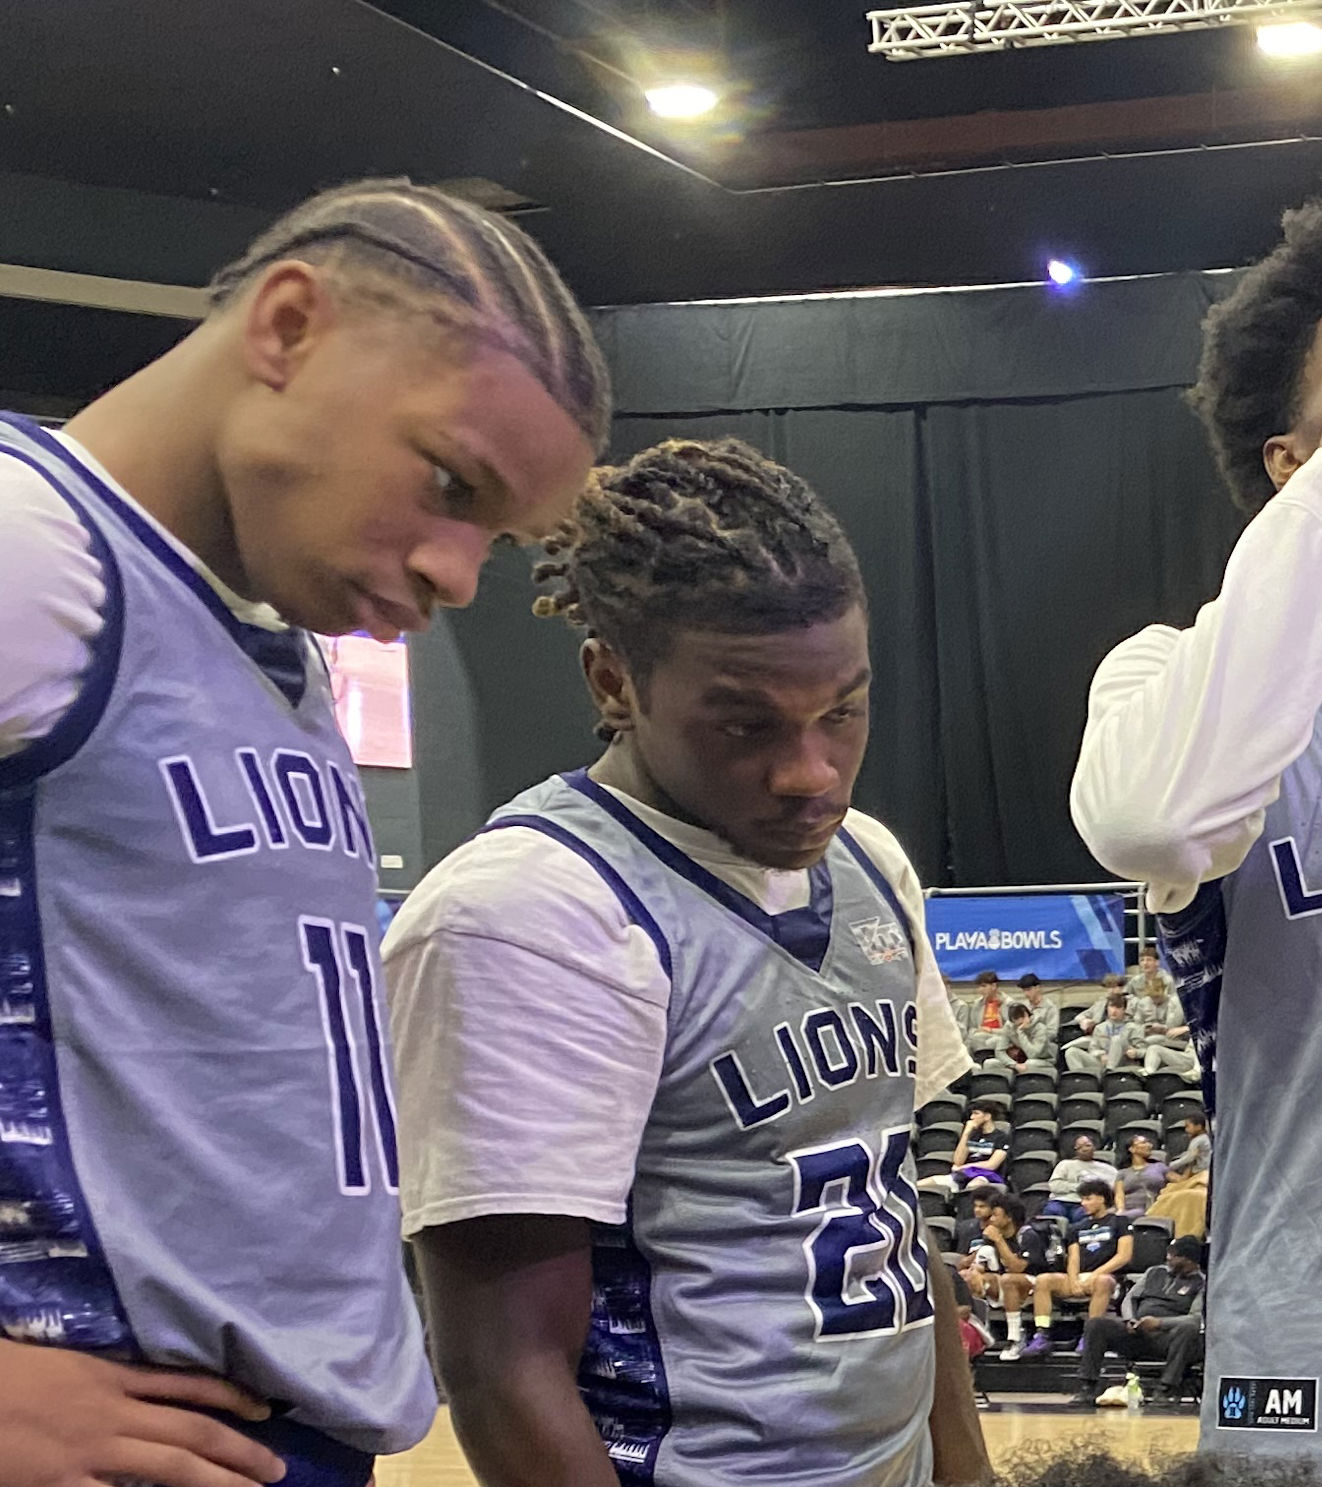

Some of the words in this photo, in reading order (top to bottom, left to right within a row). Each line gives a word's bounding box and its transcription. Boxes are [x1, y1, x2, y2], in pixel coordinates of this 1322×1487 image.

[935, 932, 988, 950] PLAYA
[1001, 930, 1062, 949] BOWLS
[299, 914, 401, 1196] 11
[1264, 1389, 1303, 1415] AM
